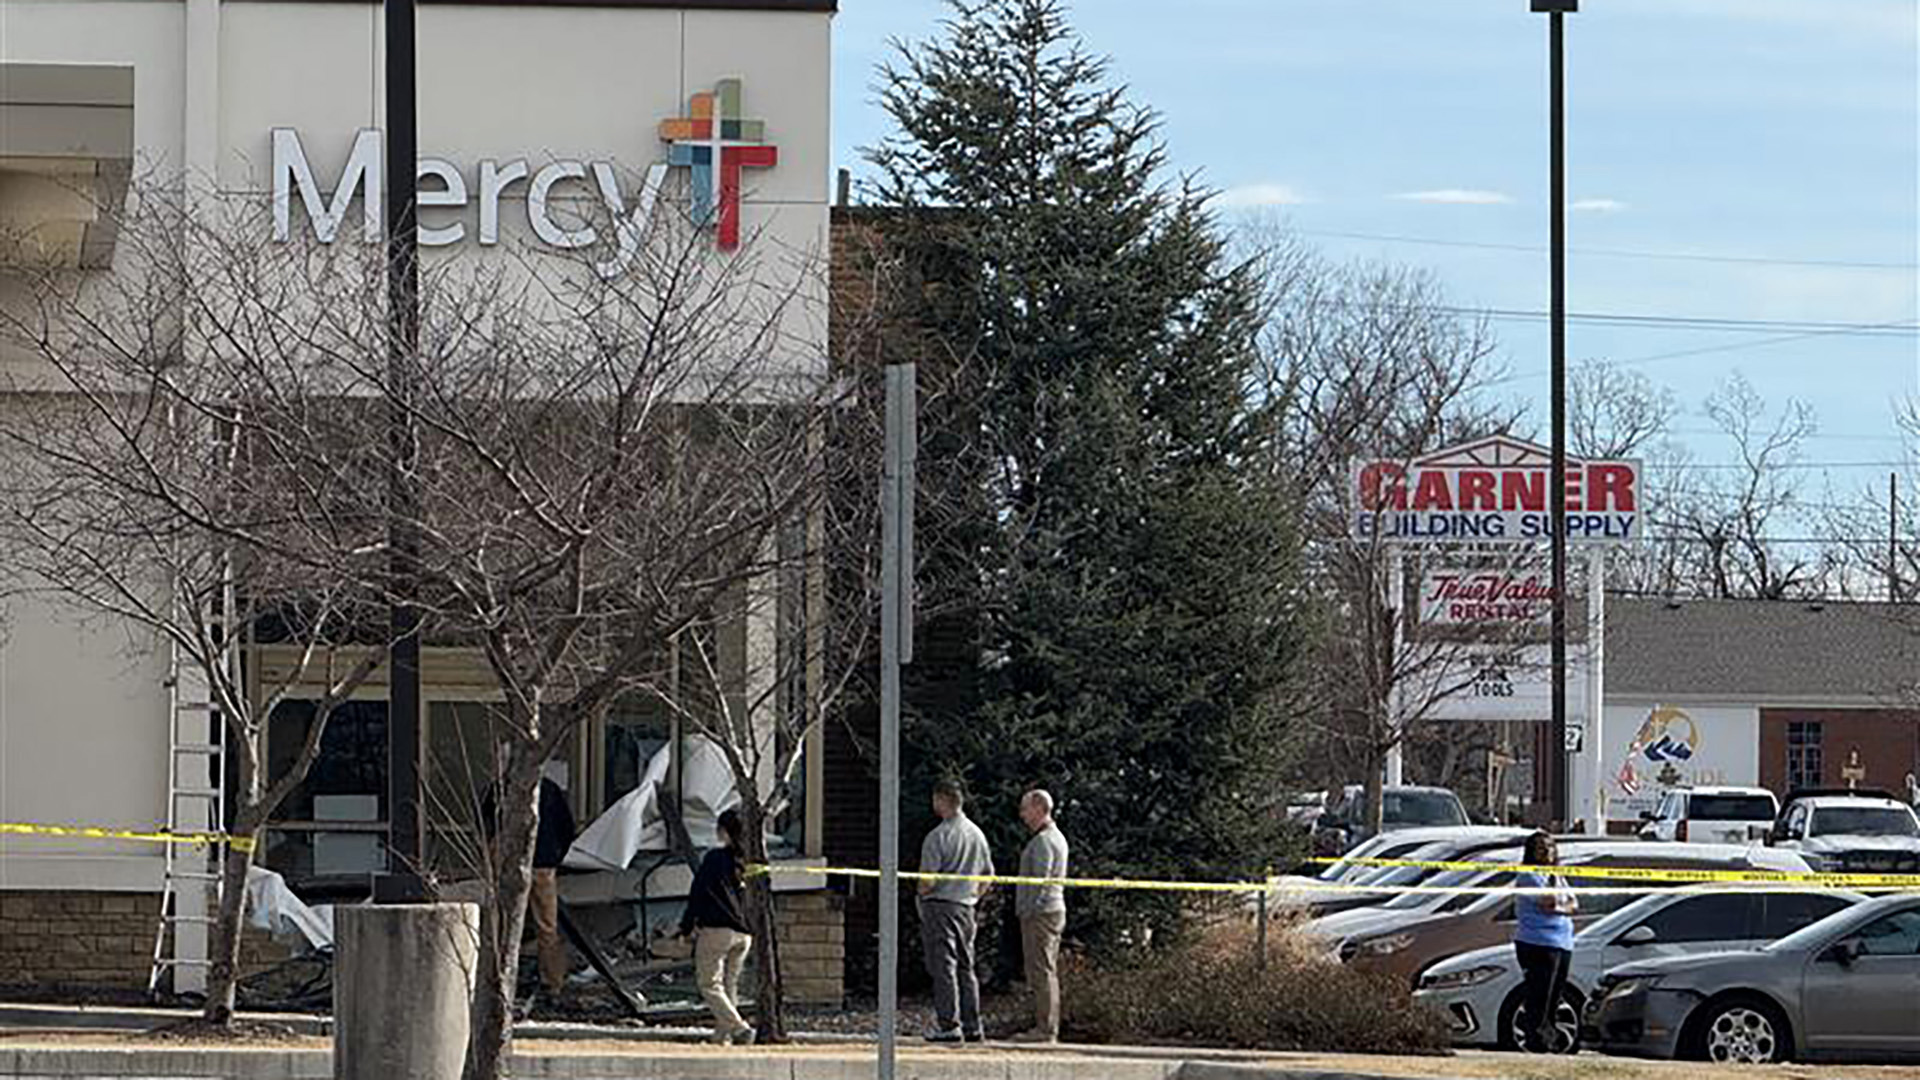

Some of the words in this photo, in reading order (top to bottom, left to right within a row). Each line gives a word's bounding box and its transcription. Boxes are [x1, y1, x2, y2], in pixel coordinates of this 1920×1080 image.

[271, 127, 668, 280] Mercy
[1359, 461, 1636, 512] GARNER
[1358, 513, 1505, 538] BUILDING
[1474, 682, 1515, 697] TOOLS
